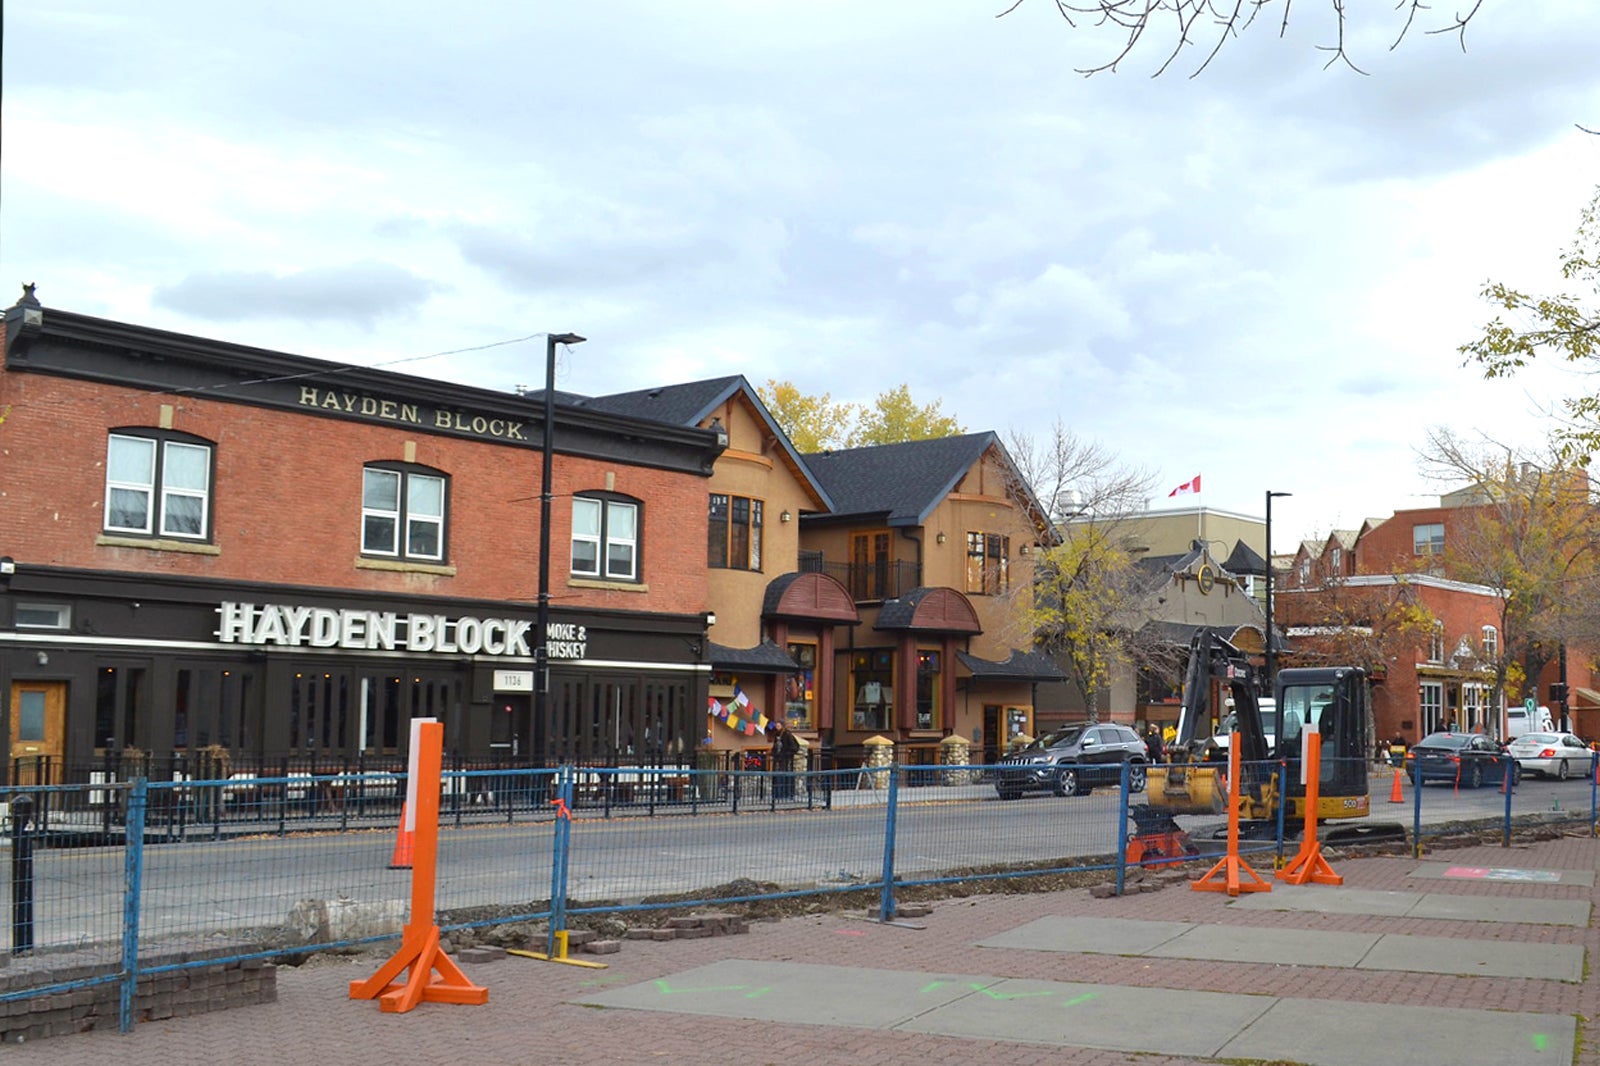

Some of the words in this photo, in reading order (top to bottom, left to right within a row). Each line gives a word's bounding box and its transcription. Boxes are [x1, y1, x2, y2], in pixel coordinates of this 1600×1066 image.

[434, 410, 528, 440] BLOCK.
[219, 601, 396, 649] HAYDEN
[406, 612, 533, 656] BLOCK
[546, 622, 576, 640] MOKE
[577, 625, 587, 641] &
[546, 641, 587, 659] HISKEY
